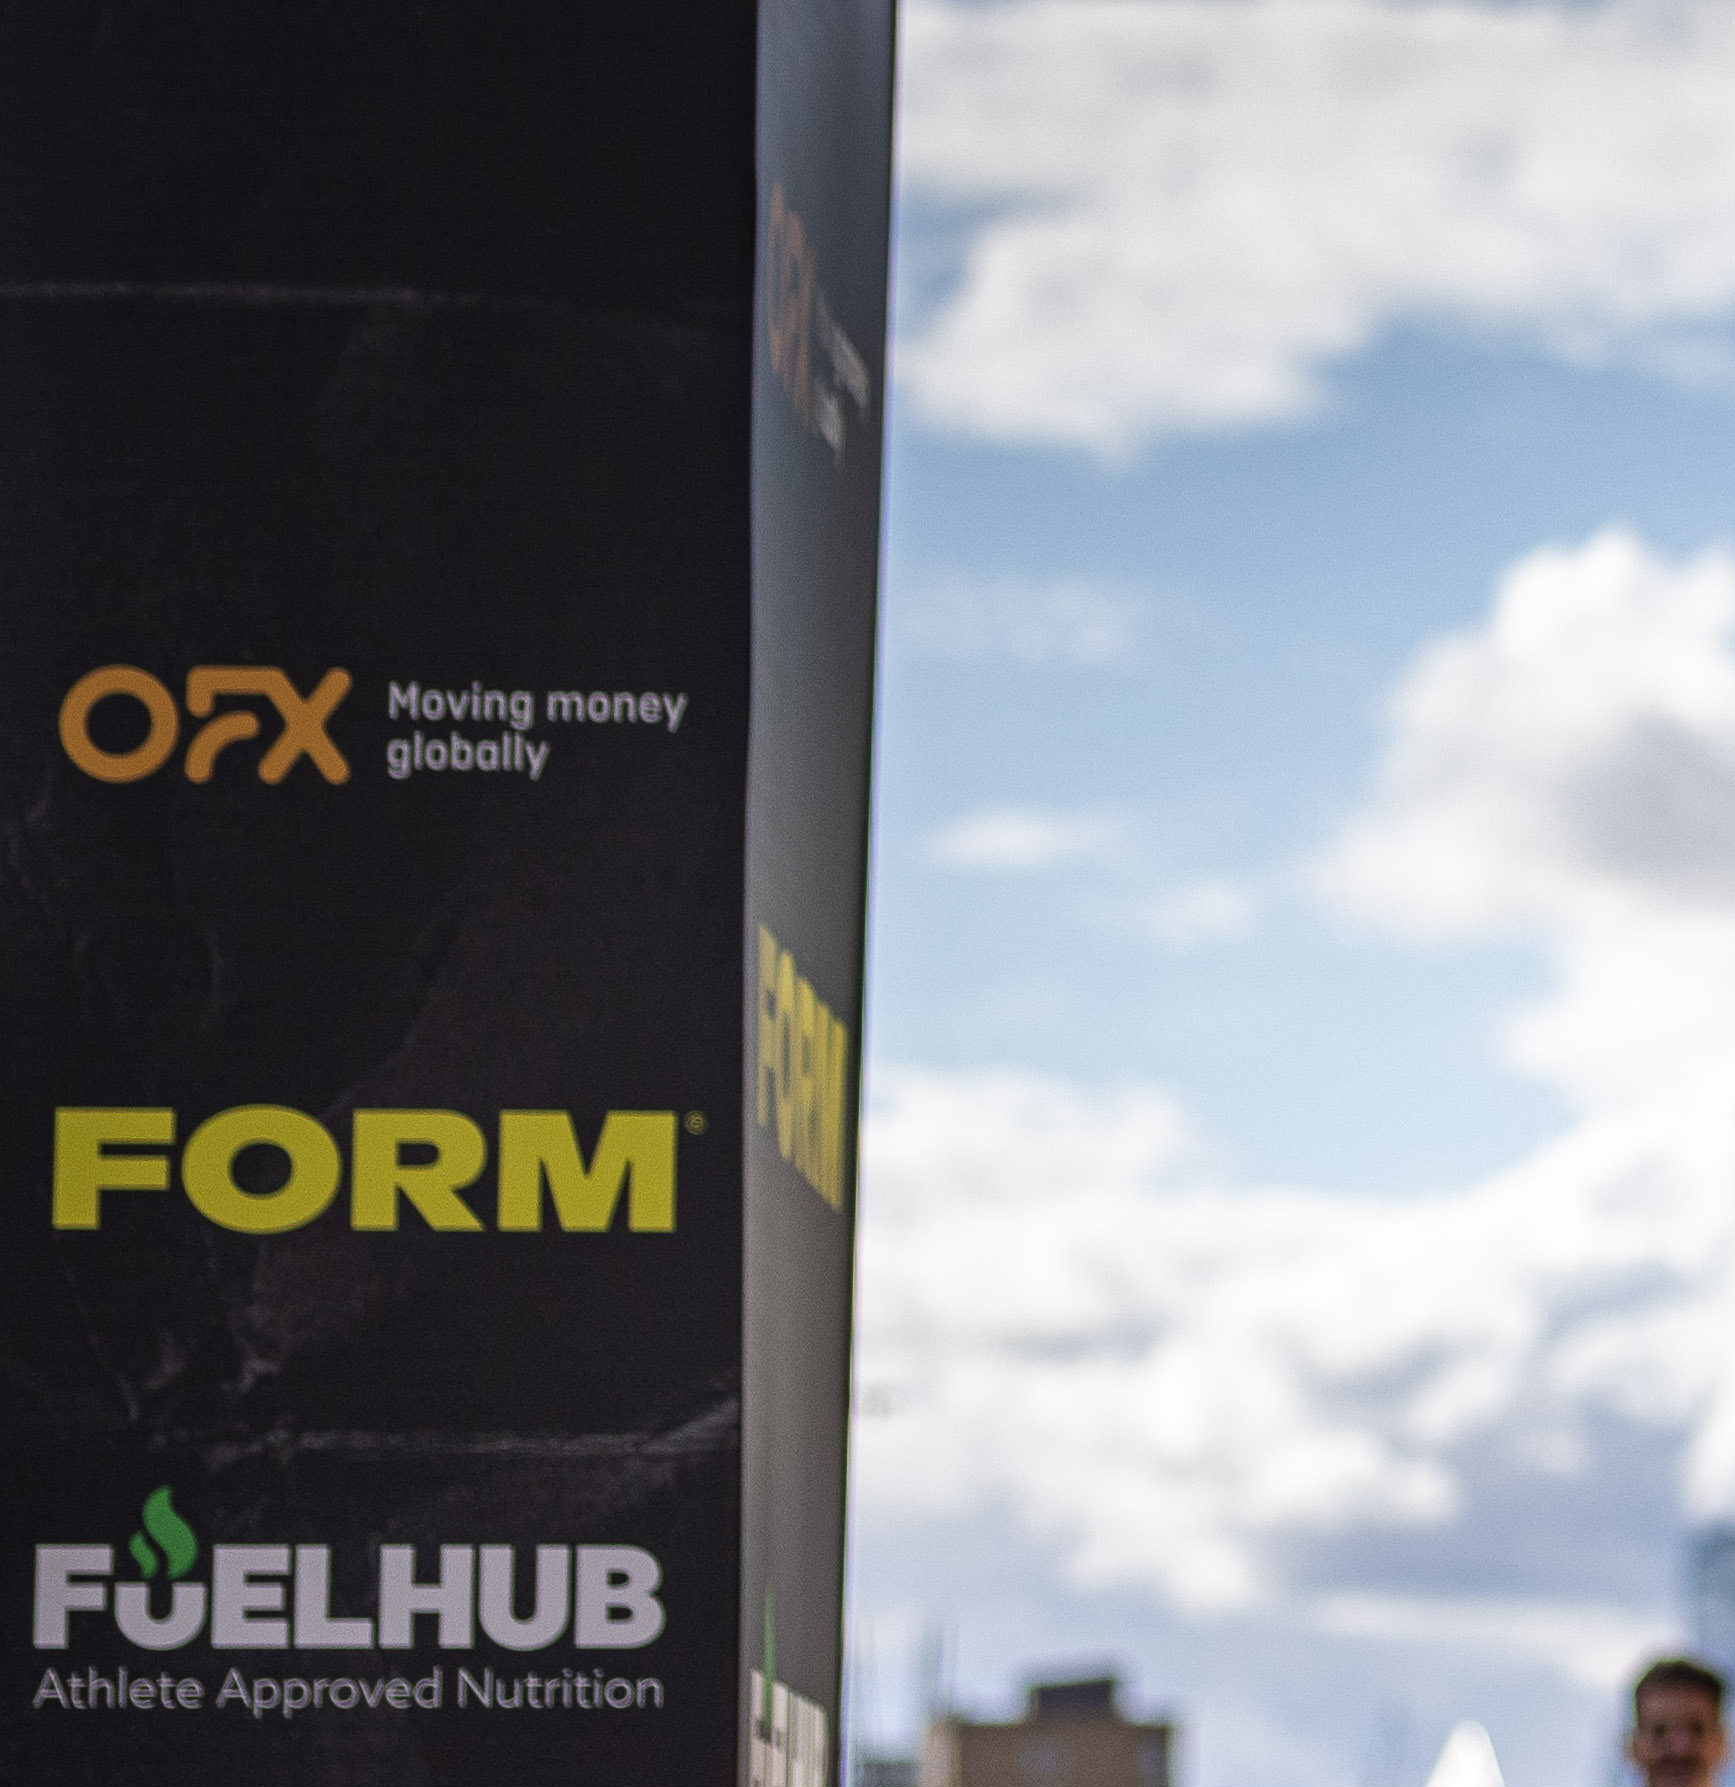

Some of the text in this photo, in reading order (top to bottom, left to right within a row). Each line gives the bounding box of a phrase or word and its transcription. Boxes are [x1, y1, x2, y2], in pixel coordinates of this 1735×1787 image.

[59, 665, 351, 784] OFX
[389, 682, 687, 738] Moving money
[387, 732, 549, 781] globally
[52, 1104, 677, 1234] FORM
[34, 1544, 665, 1651] FUELHUB
[34, 1668, 663, 1718] Athlete Approved Nutrition
